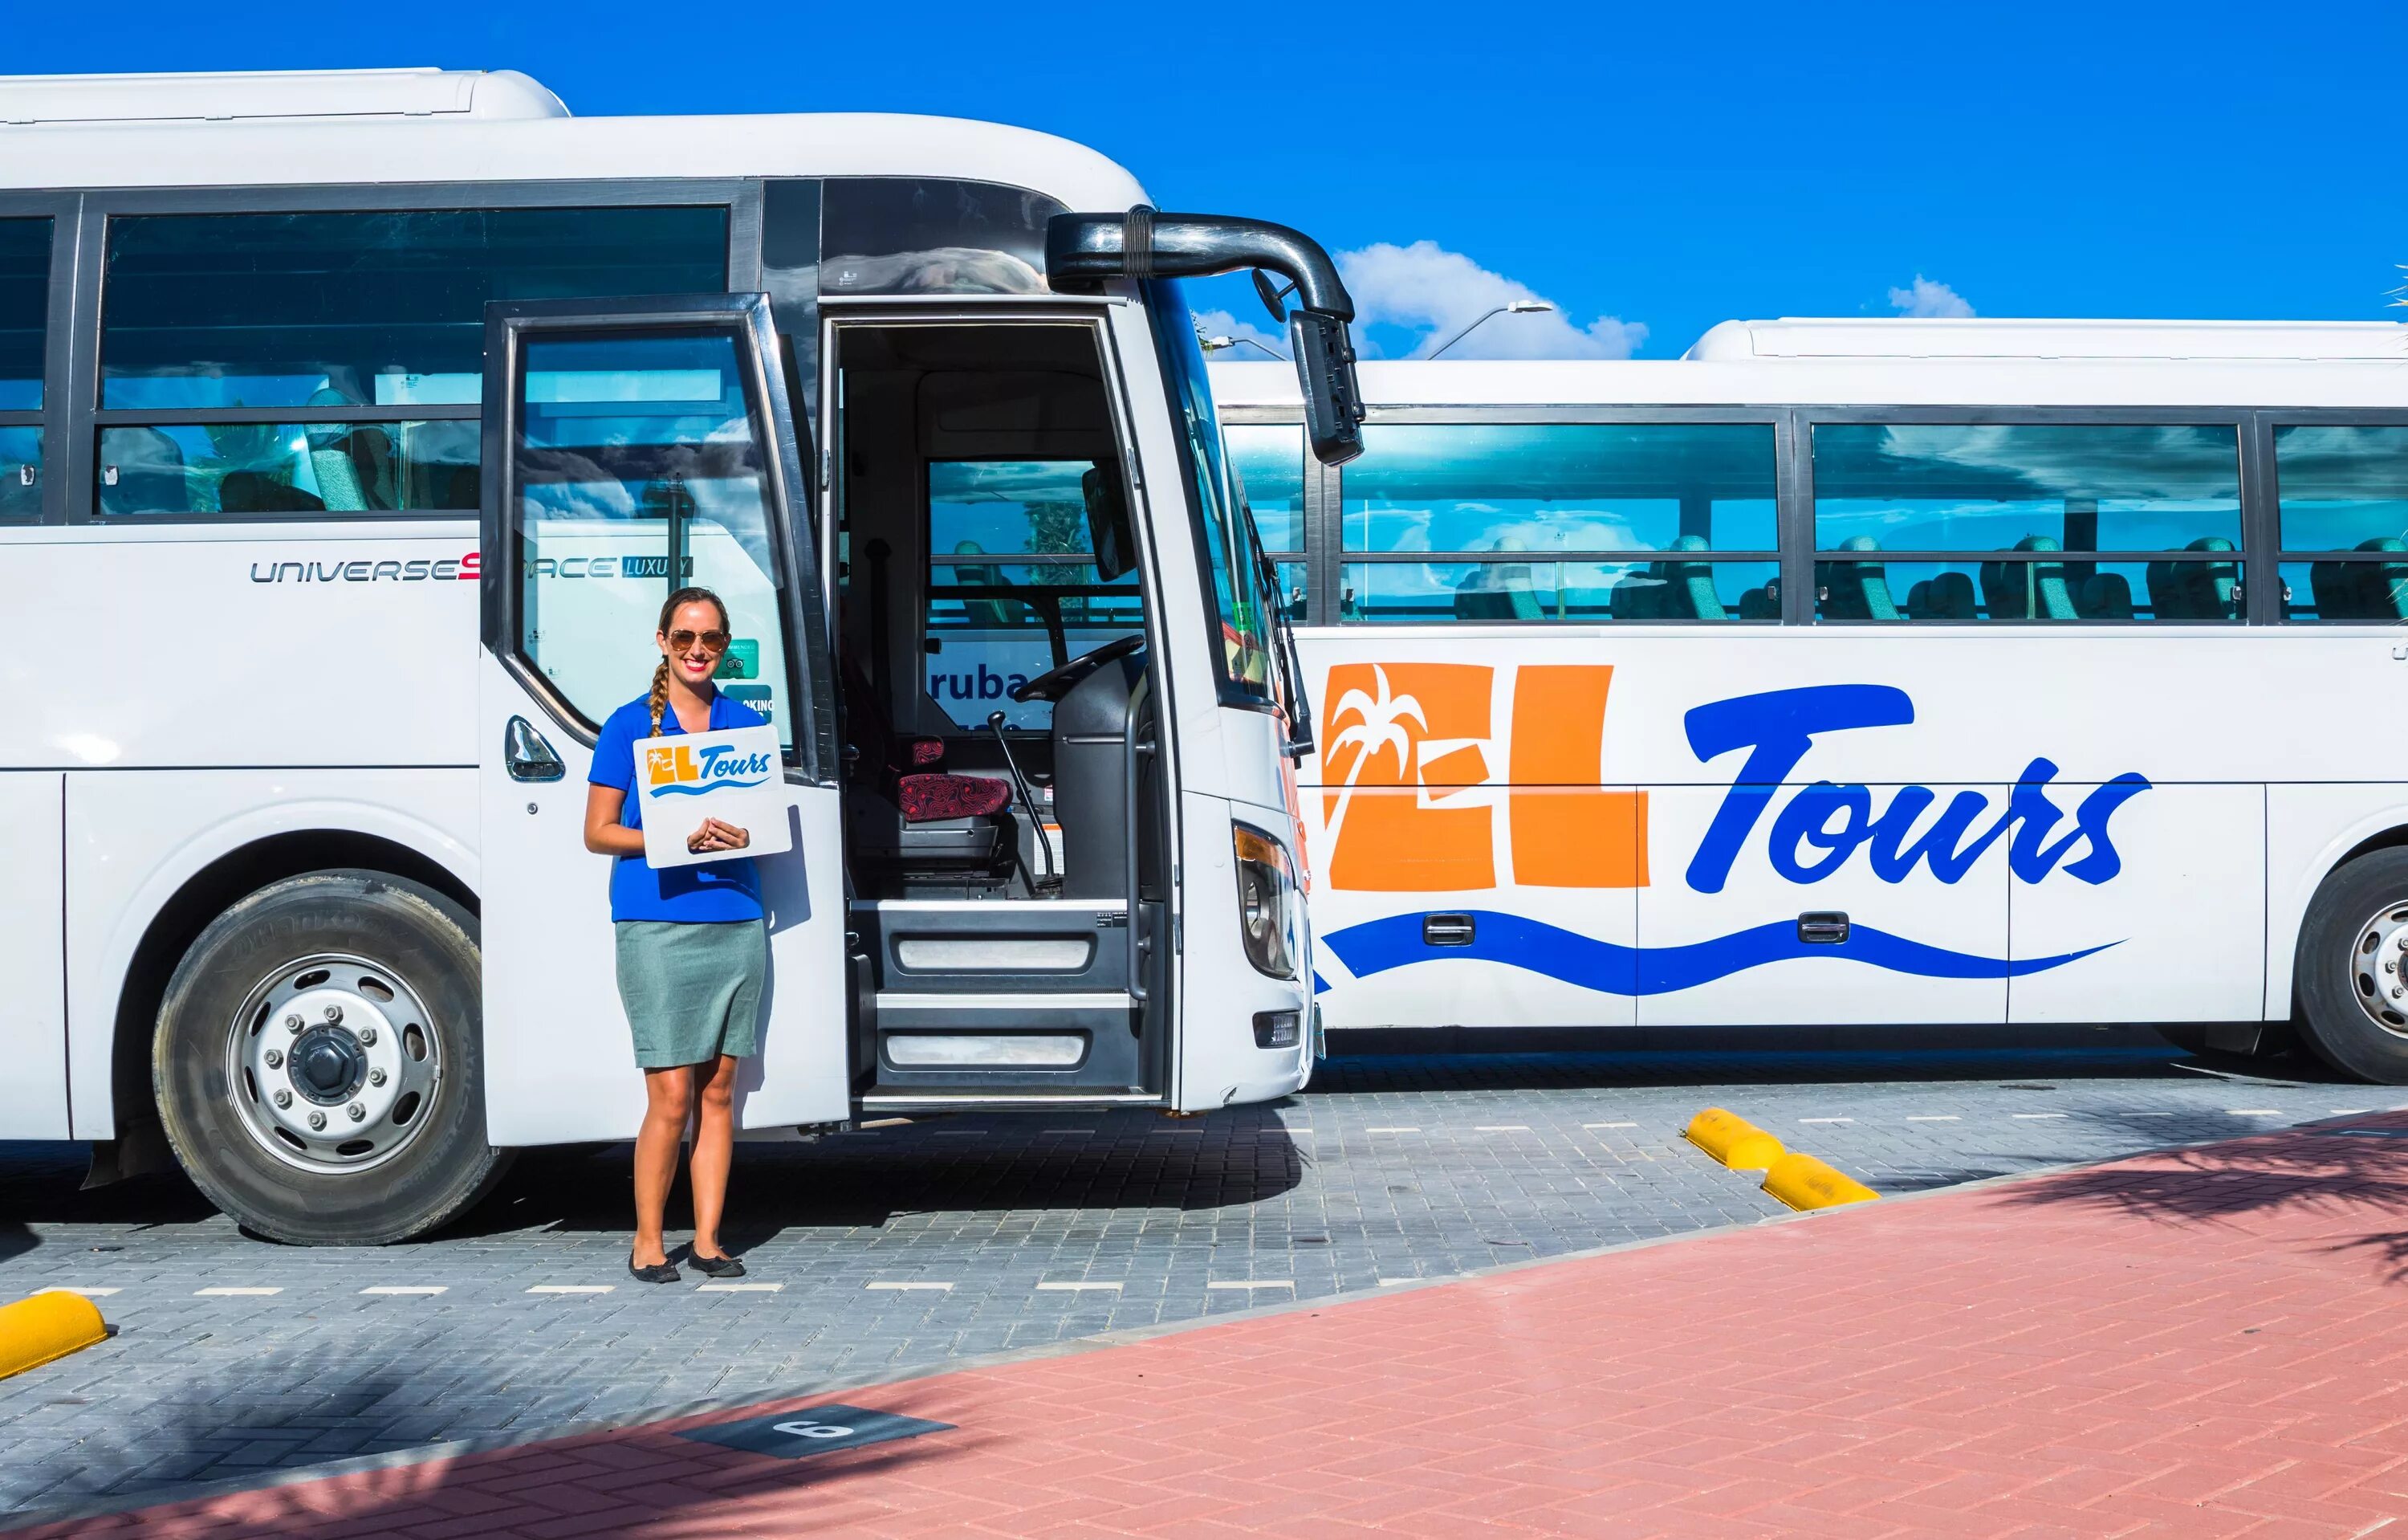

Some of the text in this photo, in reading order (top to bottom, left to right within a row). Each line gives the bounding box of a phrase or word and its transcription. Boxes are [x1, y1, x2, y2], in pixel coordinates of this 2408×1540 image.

[625, 559, 689, 576] LUXUY
[930, 662, 1029, 700] ruba
[699, 744, 772, 780] Tours
[1683, 683, 2153, 894] Tours
[773, 1420, 854, 1438] 6
